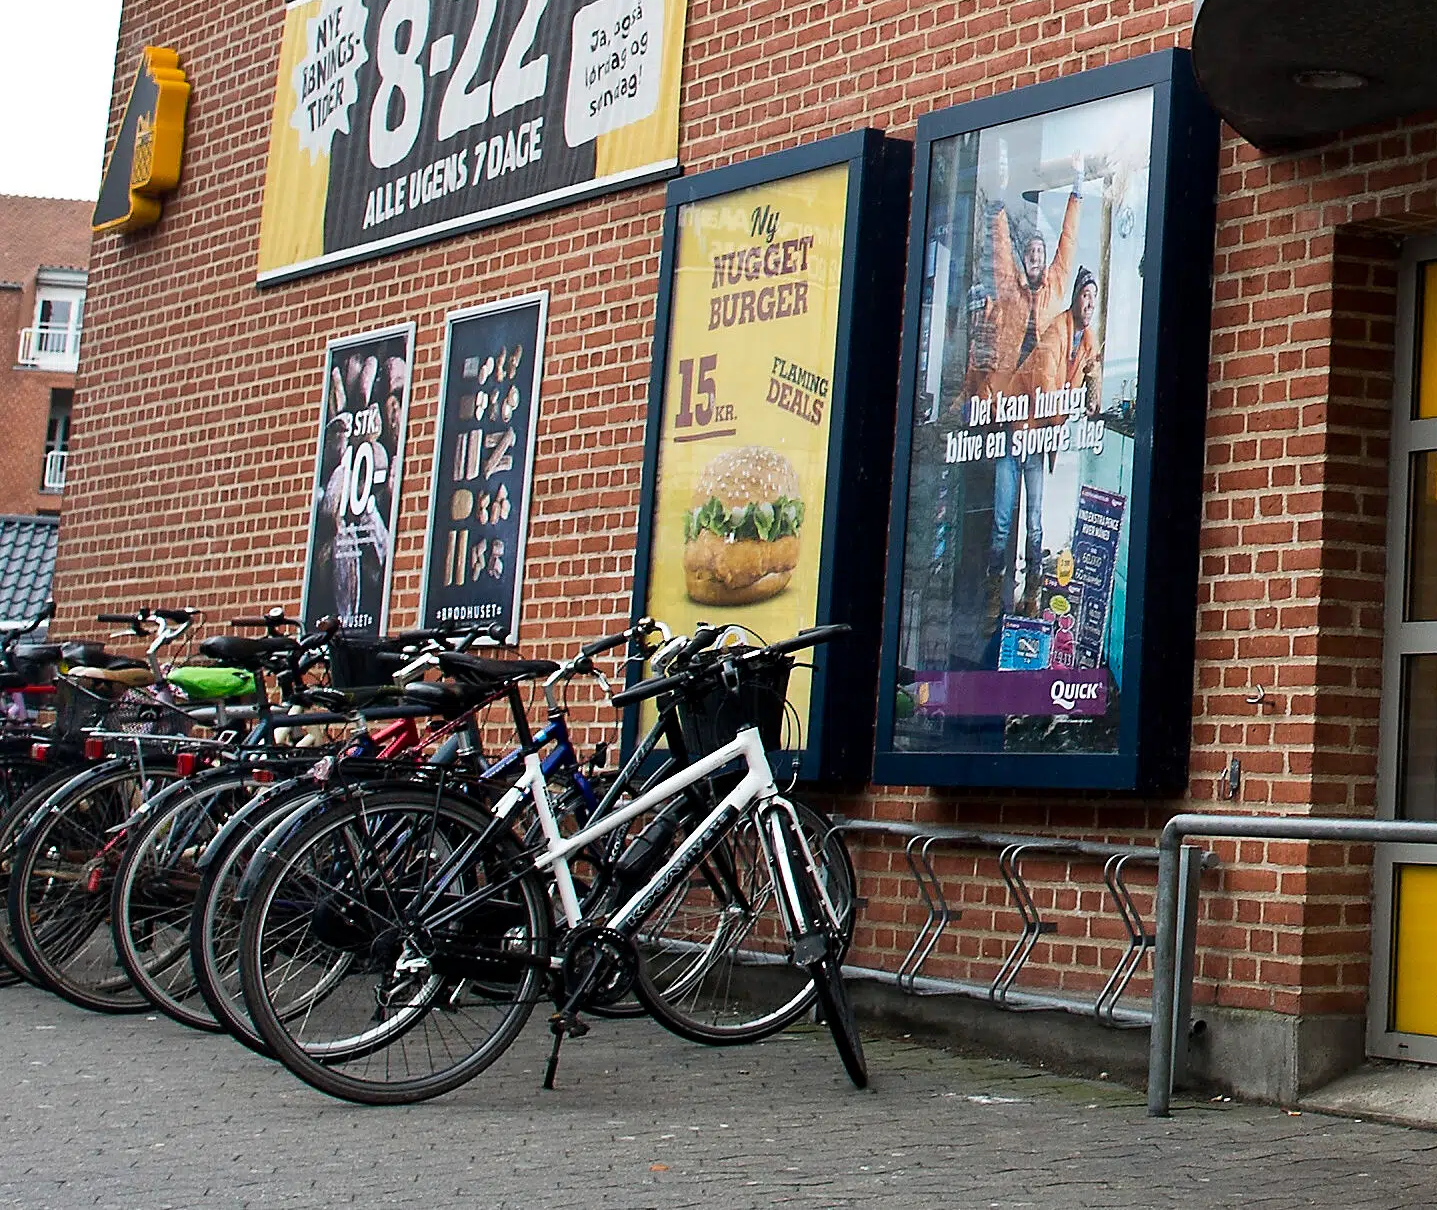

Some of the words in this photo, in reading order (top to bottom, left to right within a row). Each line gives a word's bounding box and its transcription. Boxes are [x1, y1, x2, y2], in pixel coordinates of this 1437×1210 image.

[316, 6, 343, 53] NYE
[630, 31, 649, 56] og
[307, 77, 345, 133] TIDER
[362, 174, 407, 230] ALLE
[408, 149, 468, 211] UGENS
[751, 205, 779, 243] Ny
[711, 236, 814, 289] NUGGET
[708, 281, 808, 331] BURGER
[675, 354, 717, 428] 15
[771, 356, 829, 398] FLAMING
[766, 378, 824, 426] DEALS
[969, 393, 992, 427] Det
[995, 391, 1029, 423] kan
[1034, 381, 1088, 422] hurtigt
[945, 430, 983, 463] blive
[985, 431, 1007, 459] en
[1011, 423, 1071, 463] sjovere
[1076, 416, 1105, 454] dag
